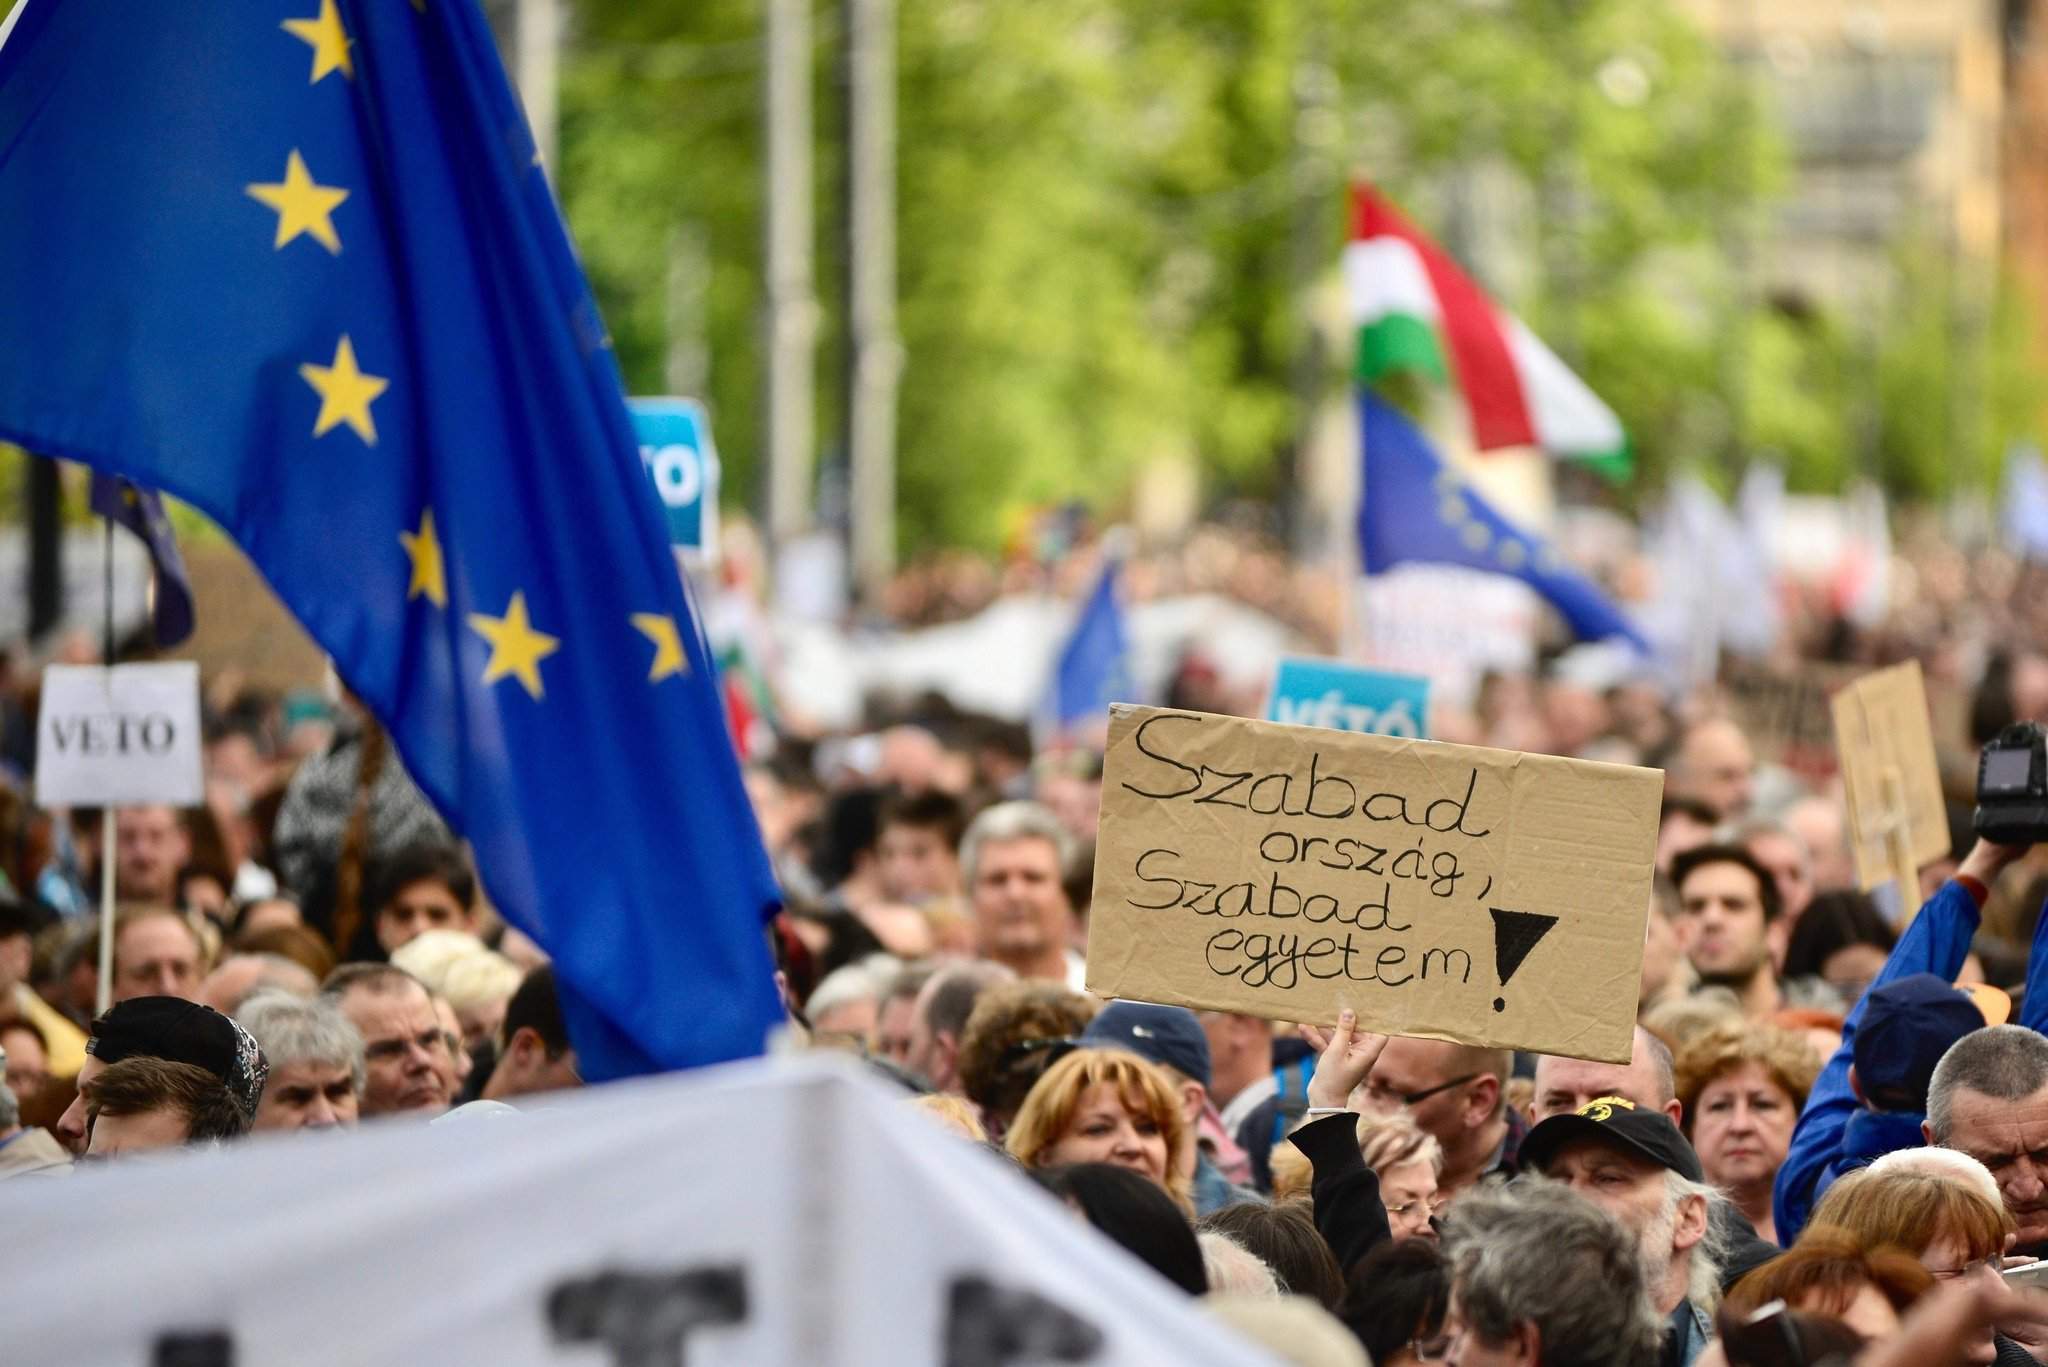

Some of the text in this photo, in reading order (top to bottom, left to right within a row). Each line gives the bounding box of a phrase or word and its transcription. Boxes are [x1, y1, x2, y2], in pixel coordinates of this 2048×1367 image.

[51, 712, 176, 757] VETO
[1121, 714, 1491, 838] Szabad
[1127, 849, 1412, 932] Szabad
[1259, 831, 1492, 900] ország,
